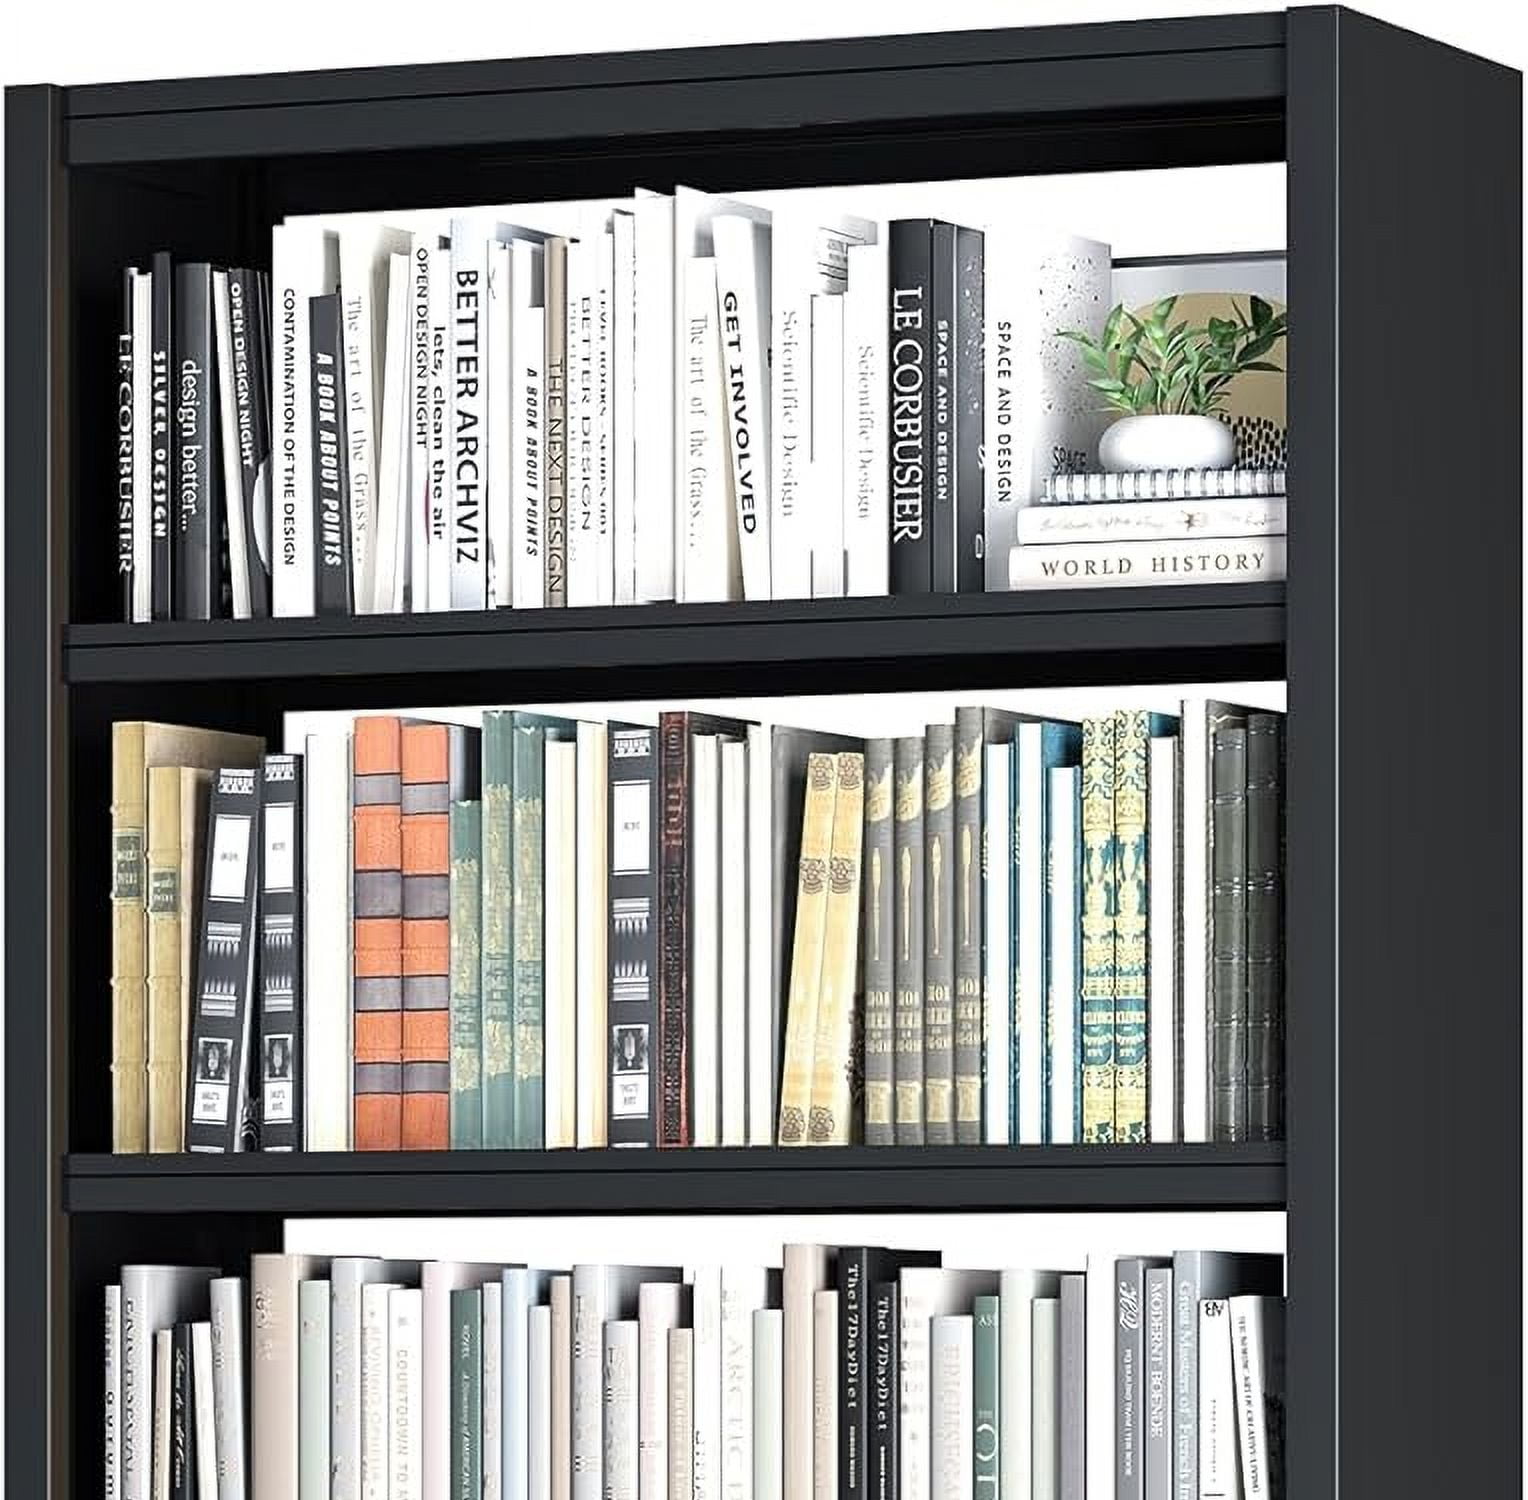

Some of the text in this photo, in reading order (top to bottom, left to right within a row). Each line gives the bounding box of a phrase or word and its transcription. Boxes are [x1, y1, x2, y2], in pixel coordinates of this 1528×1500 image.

[177, 360, 202, 438] design
[231, 283, 253, 466] OPEN DESIGN NIGHT
[284, 288, 295, 565] CONTAMINATION OF THE DESIGN
[416, 248, 428, 448] OPEN DESIGN NIGHT
[433, 386, 446, 449] clean
[456, 270, 479, 564] BETTER ARCHVIZ
[723, 291, 757, 534] GET INVOLVED
[893, 287, 923, 544] LE CORBUSIER
[937, 320, 950, 500] SPACE AND DESIGN
[997, 322, 1012, 503] SPACE AND DESIGN
[153, 352, 167, 537] SILVER DESIGN
[317, 353, 342, 566] A BOOK ABOUT POINTS
[433, 459, 446, 499] the
[433, 507, 446, 540] air
[526, 368, 538, 557] A BOOK ABOUT POINTS
[548, 358, 563, 593] THE NEXT DESIGN
[1041, 553, 1265, 577] WORLD HISTORY
